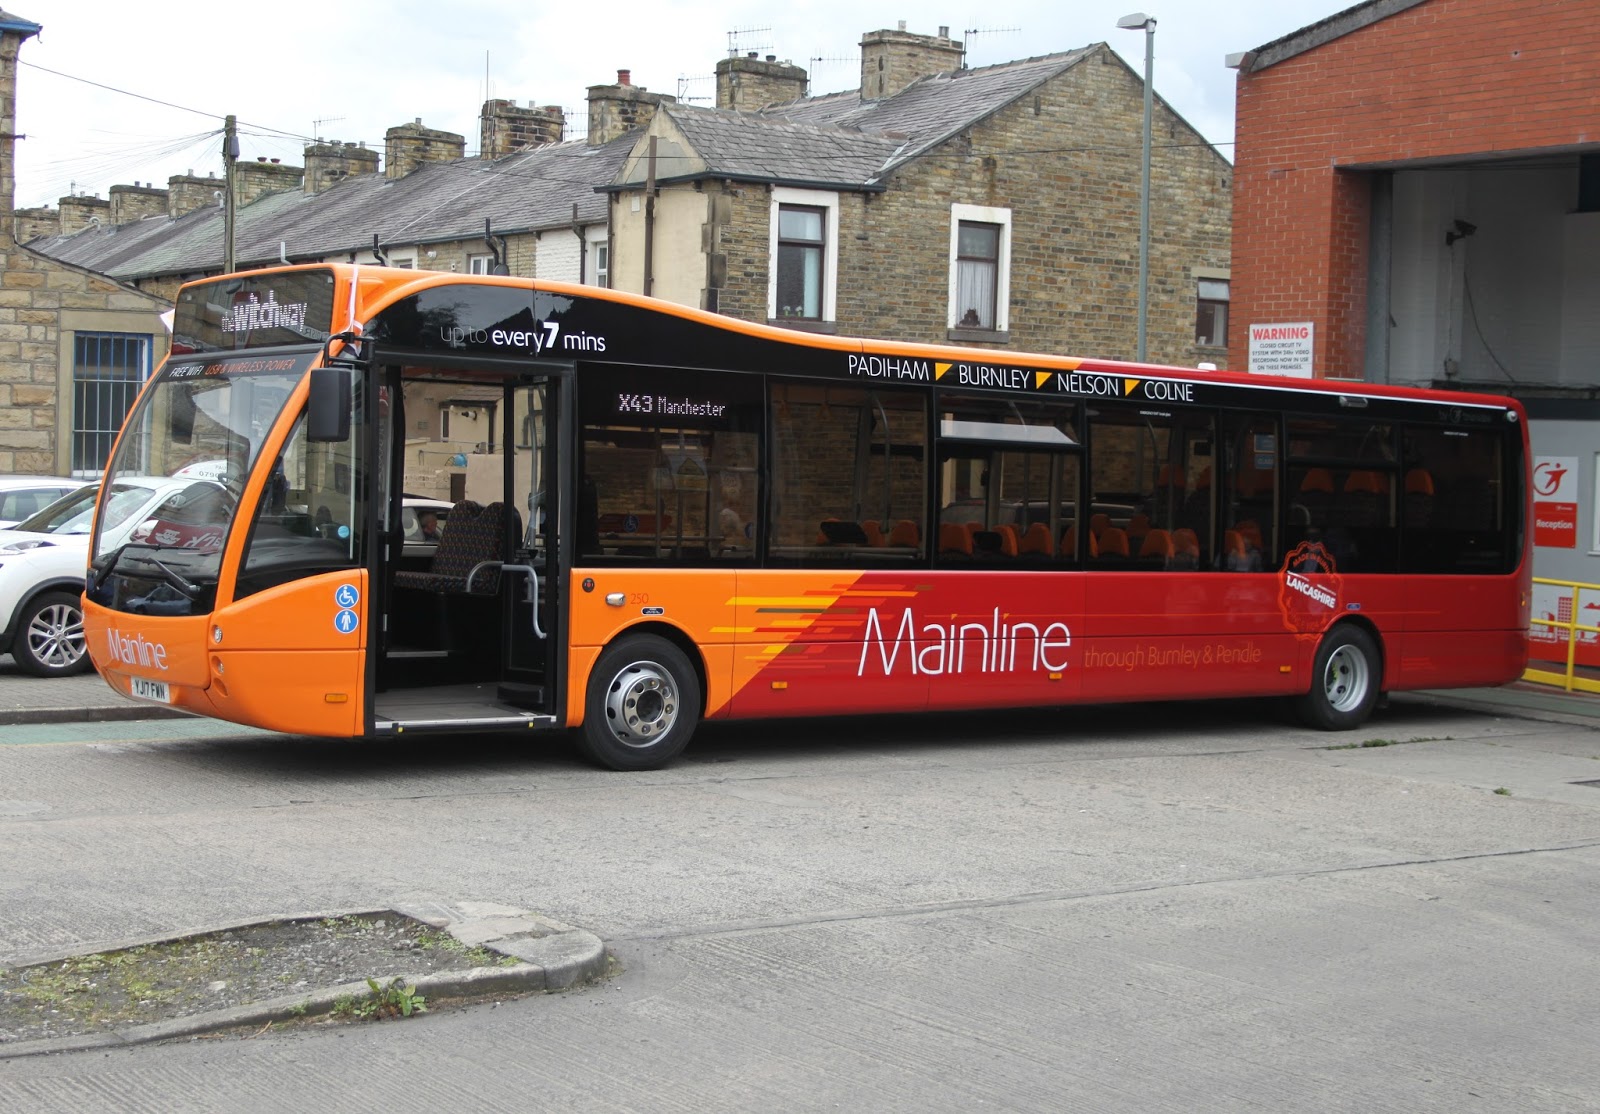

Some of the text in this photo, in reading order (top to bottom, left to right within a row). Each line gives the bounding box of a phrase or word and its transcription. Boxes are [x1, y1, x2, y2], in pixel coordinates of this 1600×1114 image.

[440, 322, 606, 352] up to every 7 mins
[1252, 327, 1309, 340] WARNING
[169, 366, 187, 377] FREE
[186, 366, 204, 376] WIFI
[205, 364, 220, 376] USB
[227, 362, 264, 373] WIRELESS
[264, 359, 296, 371] POWER
[848, 355, 1194, 402] PADIHAM BURNLEY NELSON COLNE
[619, 393, 726, 416] X43 Manchester
[1536, 519, 1573, 530] Reception
[630, 593, 649, 605] 250
[1286, 575, 1336, 609] LANCASHIRE
[108, 627, 169, 670] Mainline
[857, 606, 1071, 676] Mainline
[1084, 642, 1262, 672] through Burnley & Pendle
[134, 679, 166, 700] YJ17 FWN
